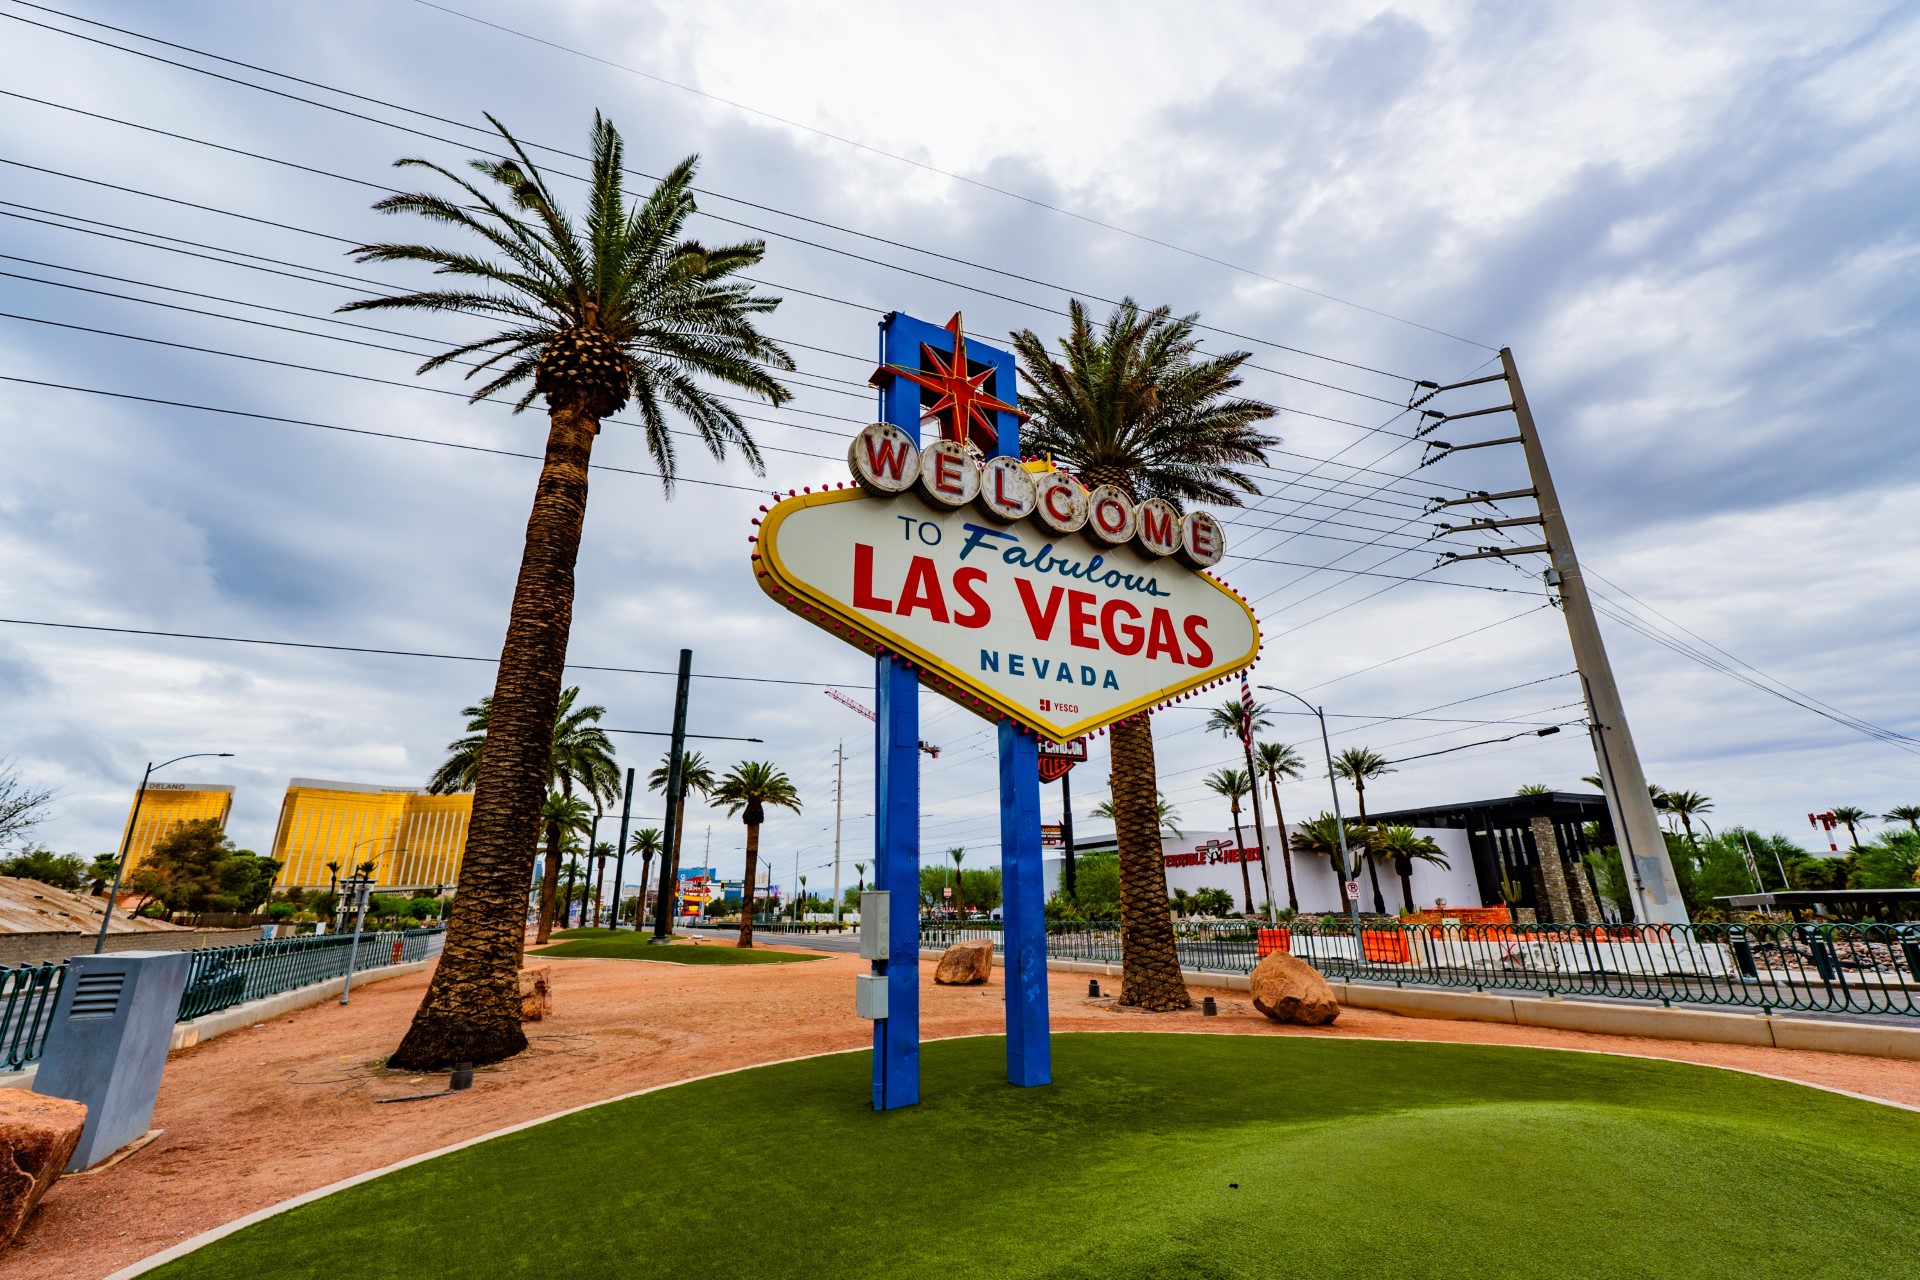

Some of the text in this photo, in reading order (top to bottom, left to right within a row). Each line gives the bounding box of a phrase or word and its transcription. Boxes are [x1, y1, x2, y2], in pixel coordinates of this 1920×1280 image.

[864, 434, 1213, 556] WELCOME
[898, 515, 1171, 597] TO Fabulous
[852, 542, 1214, 669] LAS VEGAS
[980, 649, 1120, 691] NEVADA
[1054, 702, 1079, 714] YESCO
